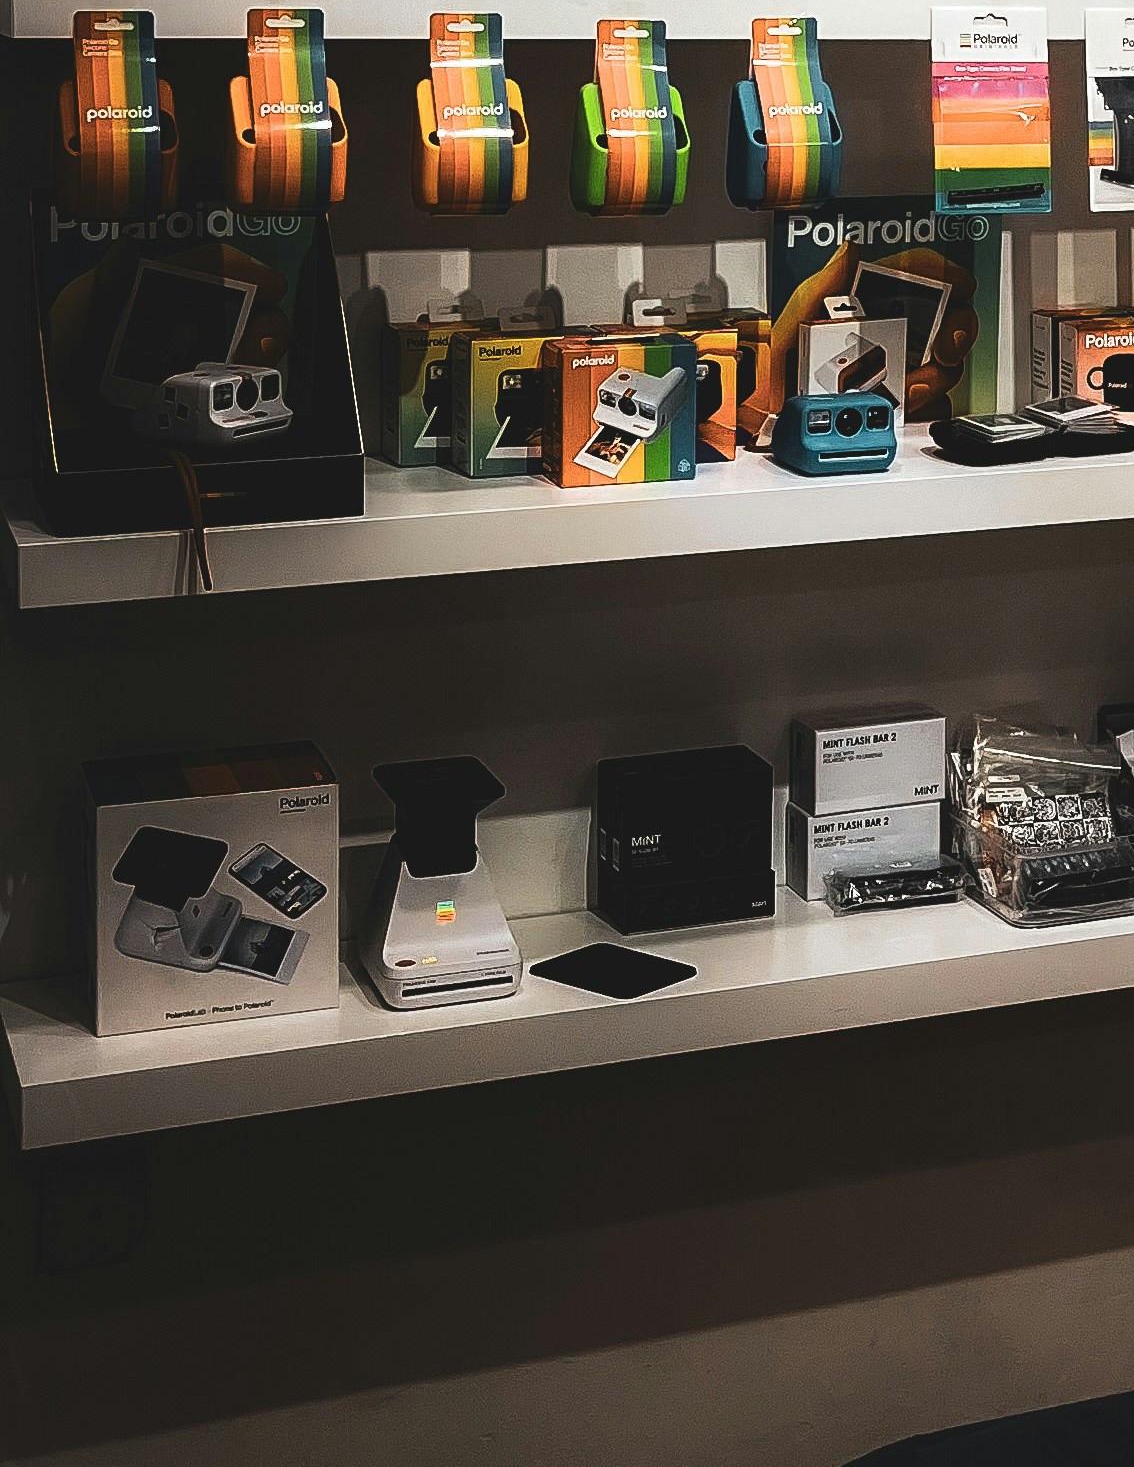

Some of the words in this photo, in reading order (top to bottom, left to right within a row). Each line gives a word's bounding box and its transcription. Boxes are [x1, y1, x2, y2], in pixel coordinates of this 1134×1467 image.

[973, 34, 1018, 44] Polaroid
[87, 105, 153, 122] polaroid
[260, 101, 323, 118] polaroid
[443, 103, 503, 119] polaroid
[610, 106, 667, 120] polaroid
[768, 102, 823, 117] polaroid
[787, 211, 990, 248] PolaroidGo
[406, 335, 450, 348] Polaroid
[478, 345, 522, 358] Polaroid
[571, 353, 615, 370] polaroid
[822, 738, 845, 750] MINT
[845, 736, 871, 747] FLASH
[872, 733, 890, 744] BAR
[890, 732, 897, 742] 2
[279, 793, 330, 810] Polaroid
[813, 823, 836, 835] MINT
[837, 820, 863, 832] FLASH
[864, 818, 882, 829] BAR
[882, 816, 890, 826] 2
